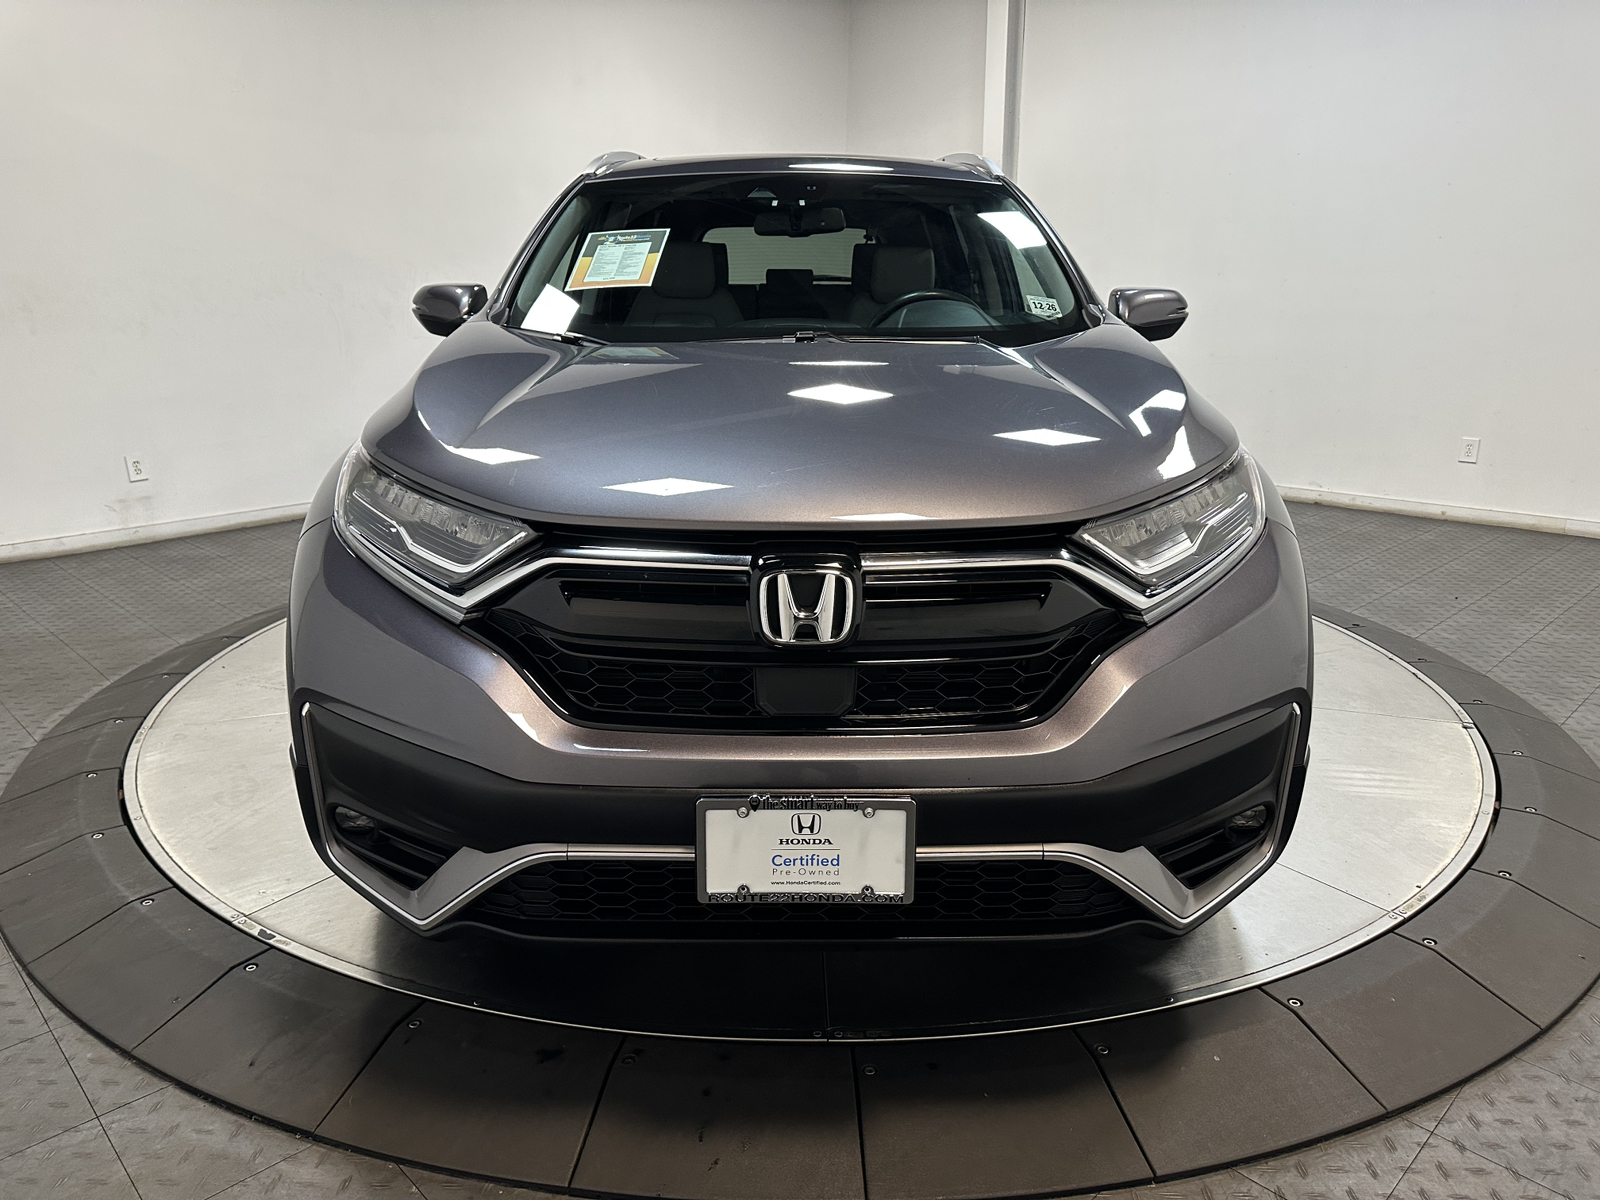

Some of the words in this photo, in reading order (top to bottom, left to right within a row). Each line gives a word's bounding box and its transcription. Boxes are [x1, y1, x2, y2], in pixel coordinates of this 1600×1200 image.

[780, 795, 814, 810] smart
[816, 803, 833, 812] way
[834, 799, 843, 810] to
[844, 796, 860, 812] buy
[778, 838, 834, 846] HONDA
[771, 853, 841, 867] Certified
[772, 868, 840, 876] Pre-Owned
[708, 893, 904, 904] ROUTE22HONDA.COM
